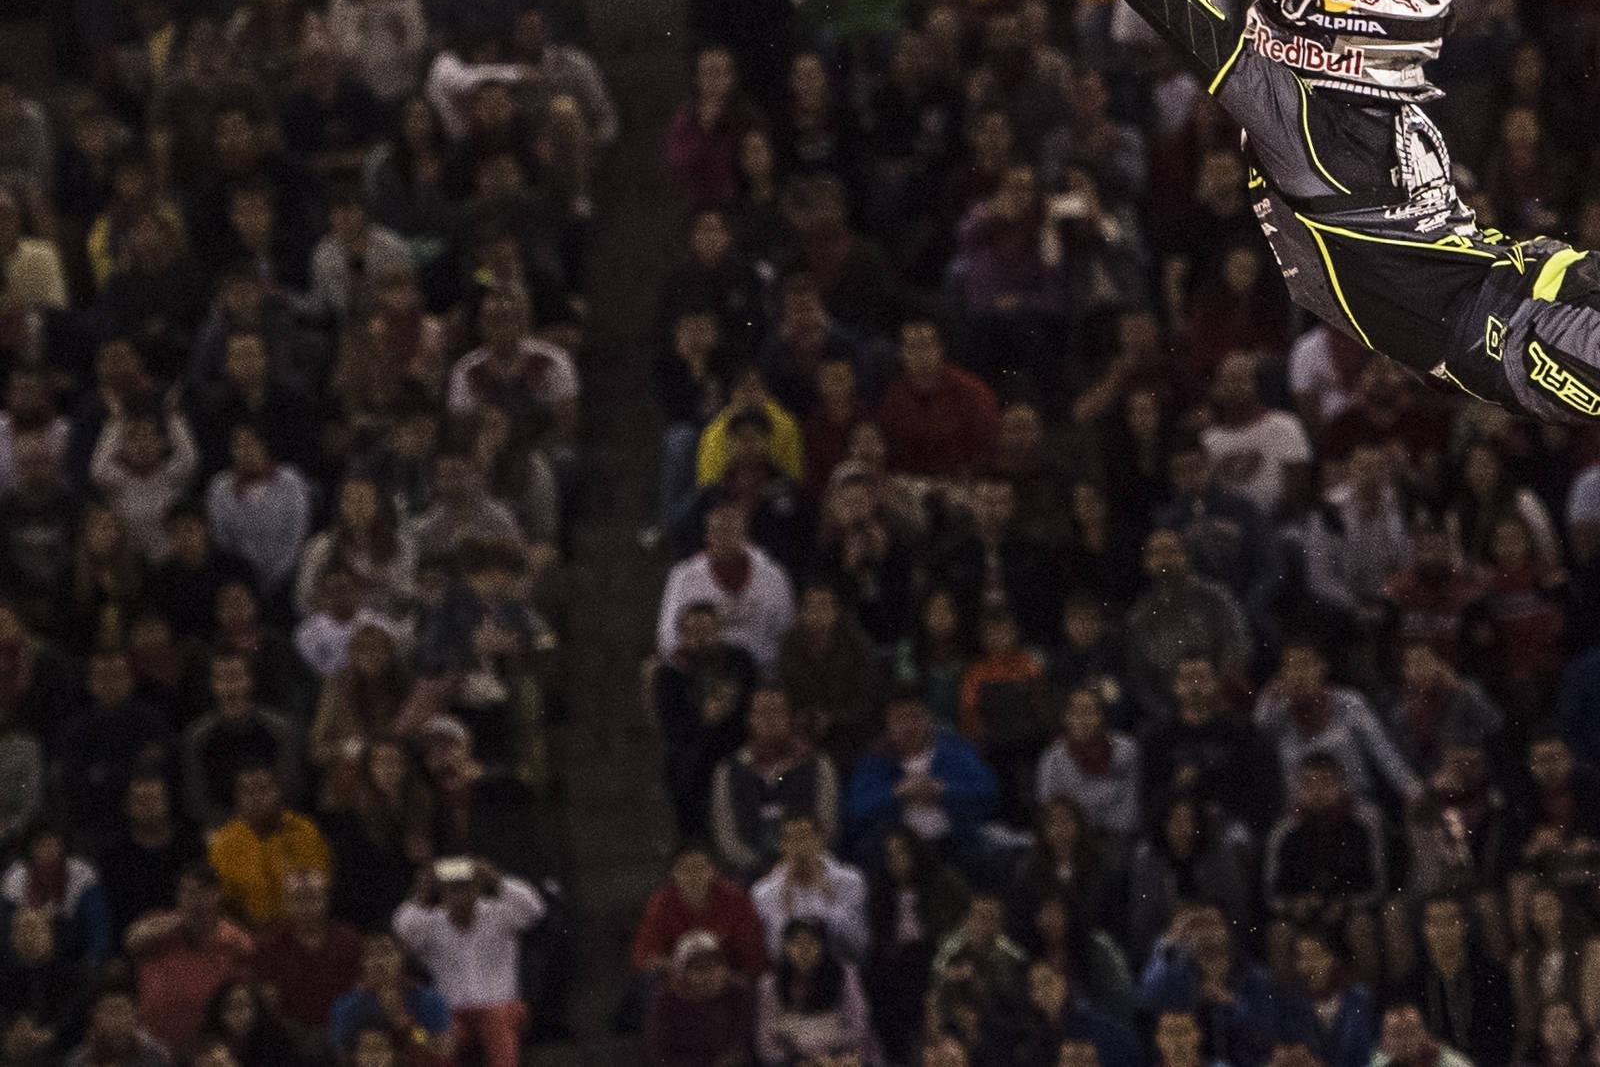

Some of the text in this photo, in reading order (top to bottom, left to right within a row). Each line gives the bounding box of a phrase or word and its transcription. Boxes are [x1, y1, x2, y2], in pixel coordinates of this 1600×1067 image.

[1308, 14, 1387, 35] ALPINA
[1254, 26, 1364, 76] Red Bull
